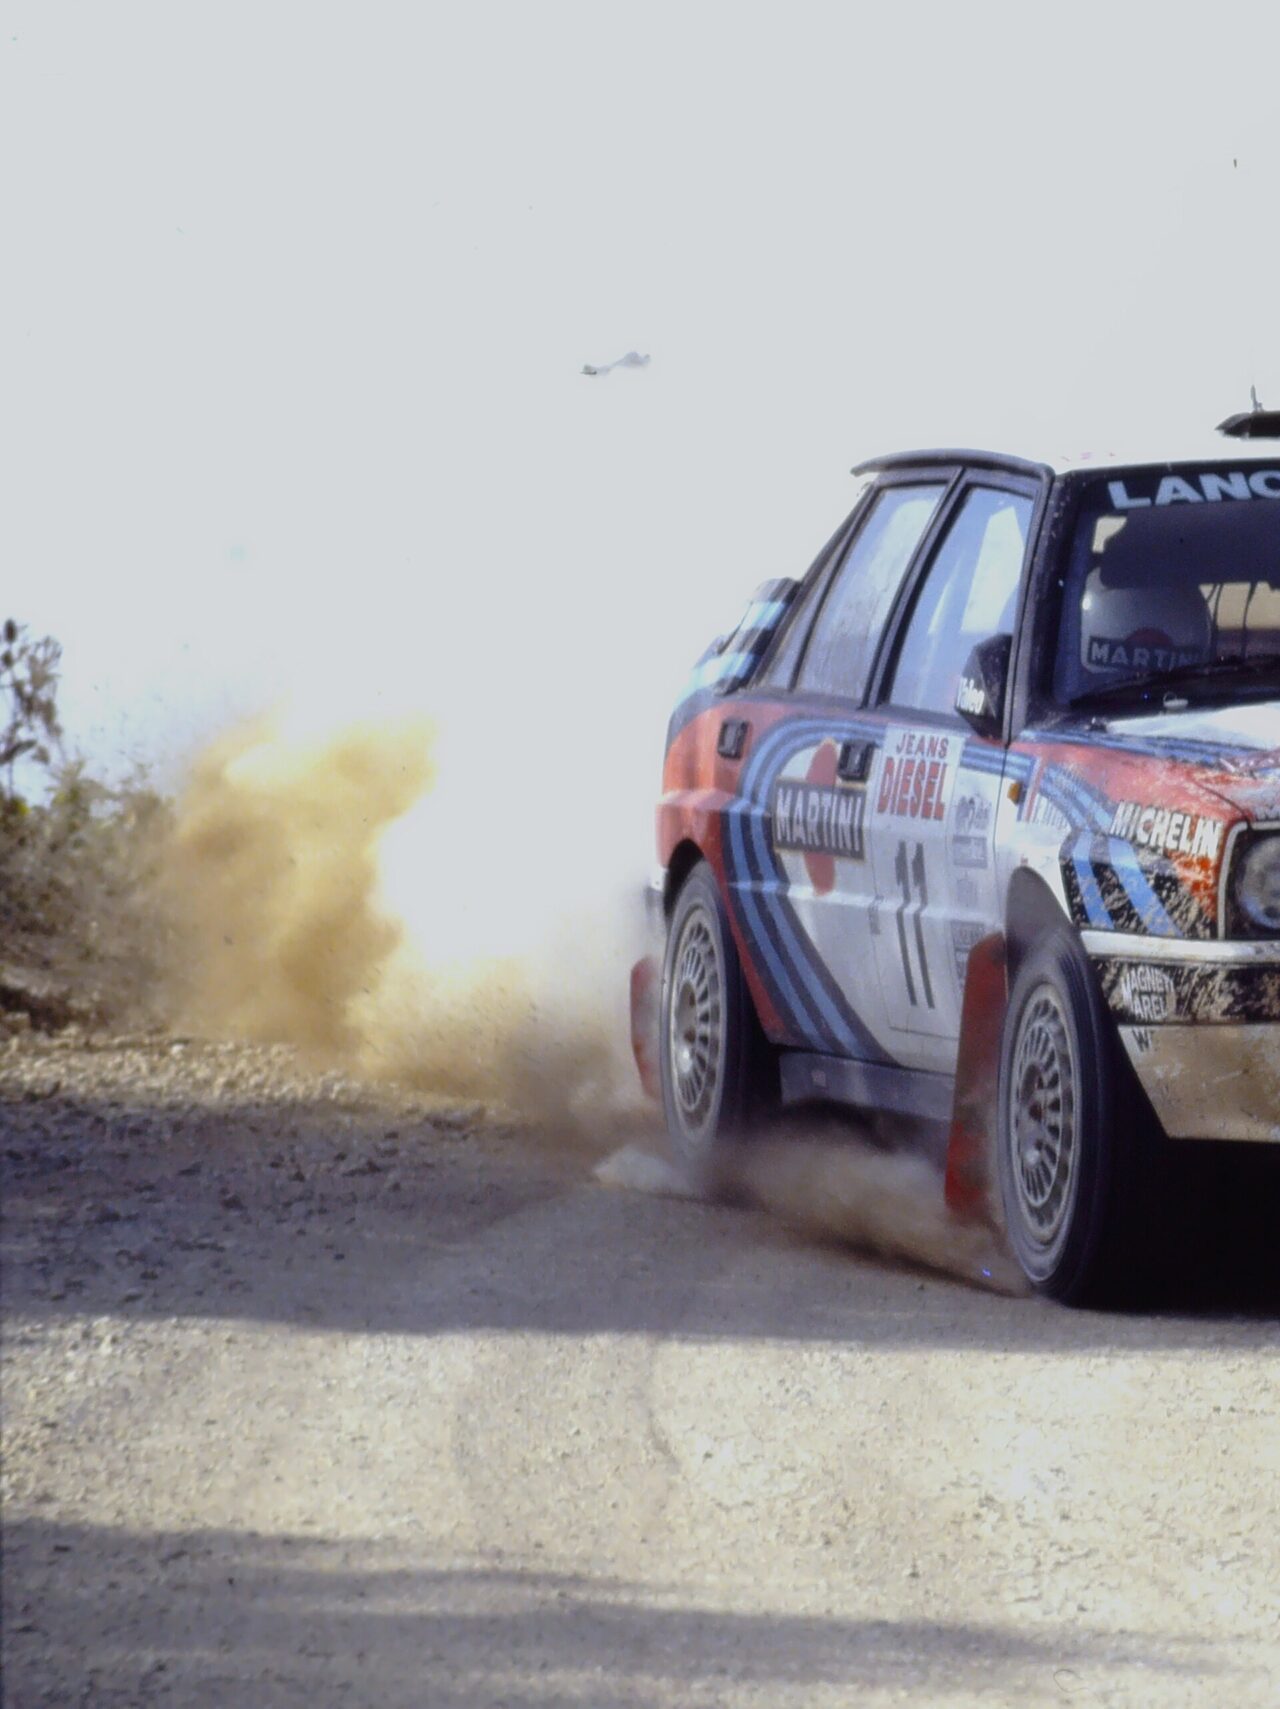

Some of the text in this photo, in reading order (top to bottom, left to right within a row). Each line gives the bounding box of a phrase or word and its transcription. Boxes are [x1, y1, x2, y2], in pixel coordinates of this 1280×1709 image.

[896, 733, 949, 759] JEANS
[775, 787, 864, 853] MARTINI
[877, 756, 948, 820] DIESEL
[1109, 800, 1224, 859] MICHELIN
[894, 839, 935, 1010] 11
